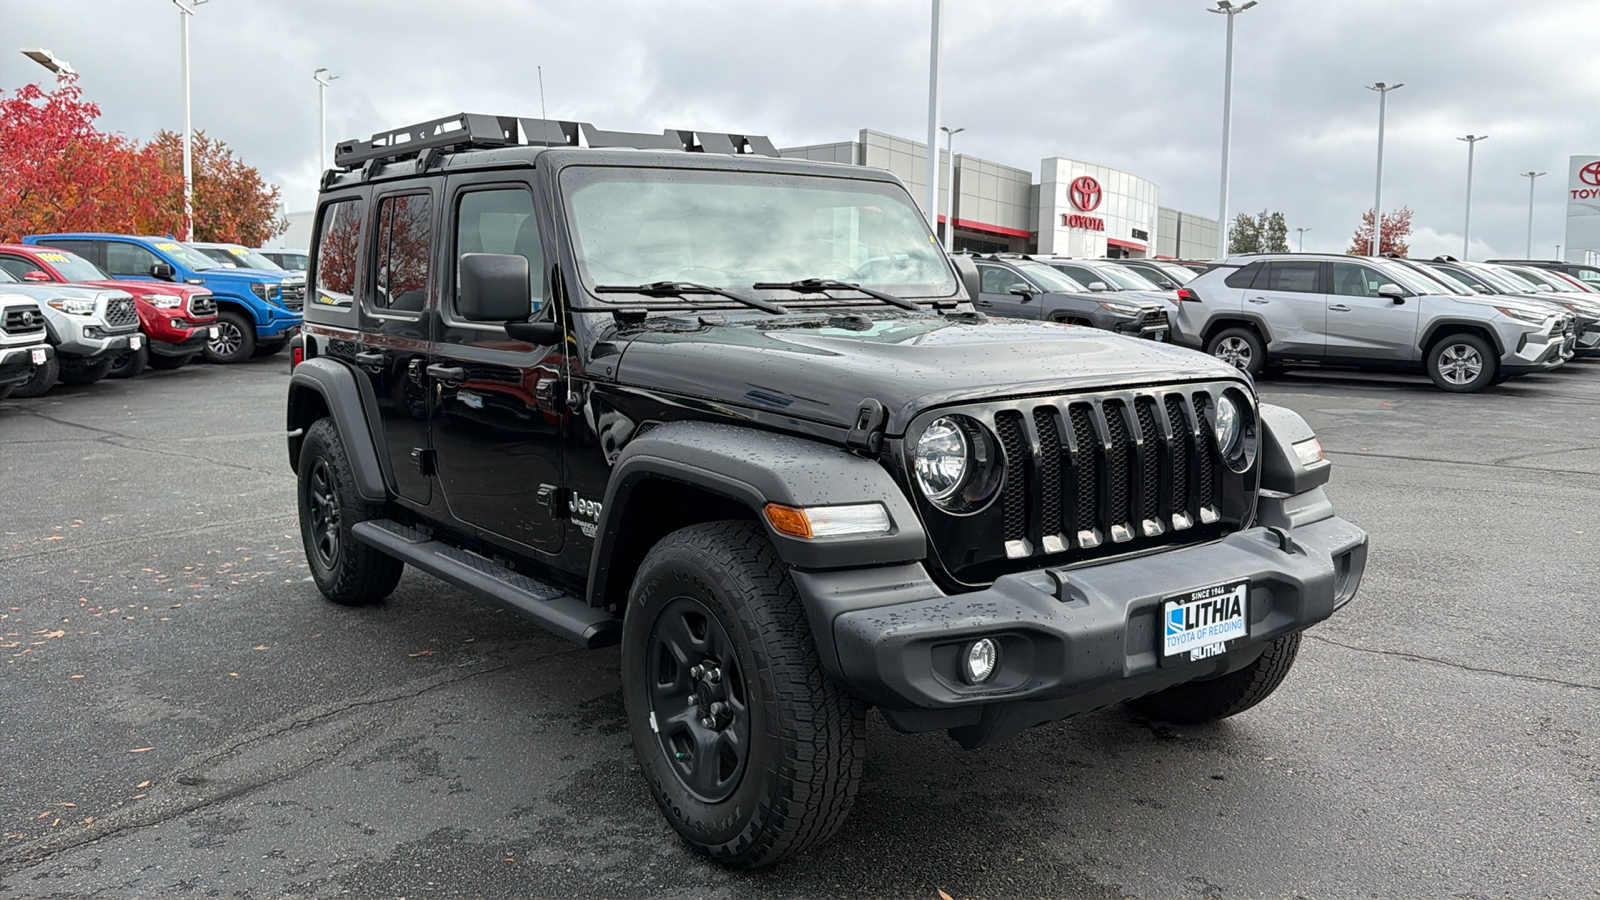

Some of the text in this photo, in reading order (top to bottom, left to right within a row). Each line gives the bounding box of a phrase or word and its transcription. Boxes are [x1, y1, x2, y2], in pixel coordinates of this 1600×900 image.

[1570, 188, 1600, 200] TOY
[1061, 213, 1105, 232] TOYOTA
[569, 491, 603, 523] Jeep
[1191, 586, 1225, 601] SINCE 1946
[1184, 594, 1242, 631] LITHIA
[1167, 619, 1243, 648] TOYOTA OF REDDING
[1199, 641, 1227, 660] LITHIA
